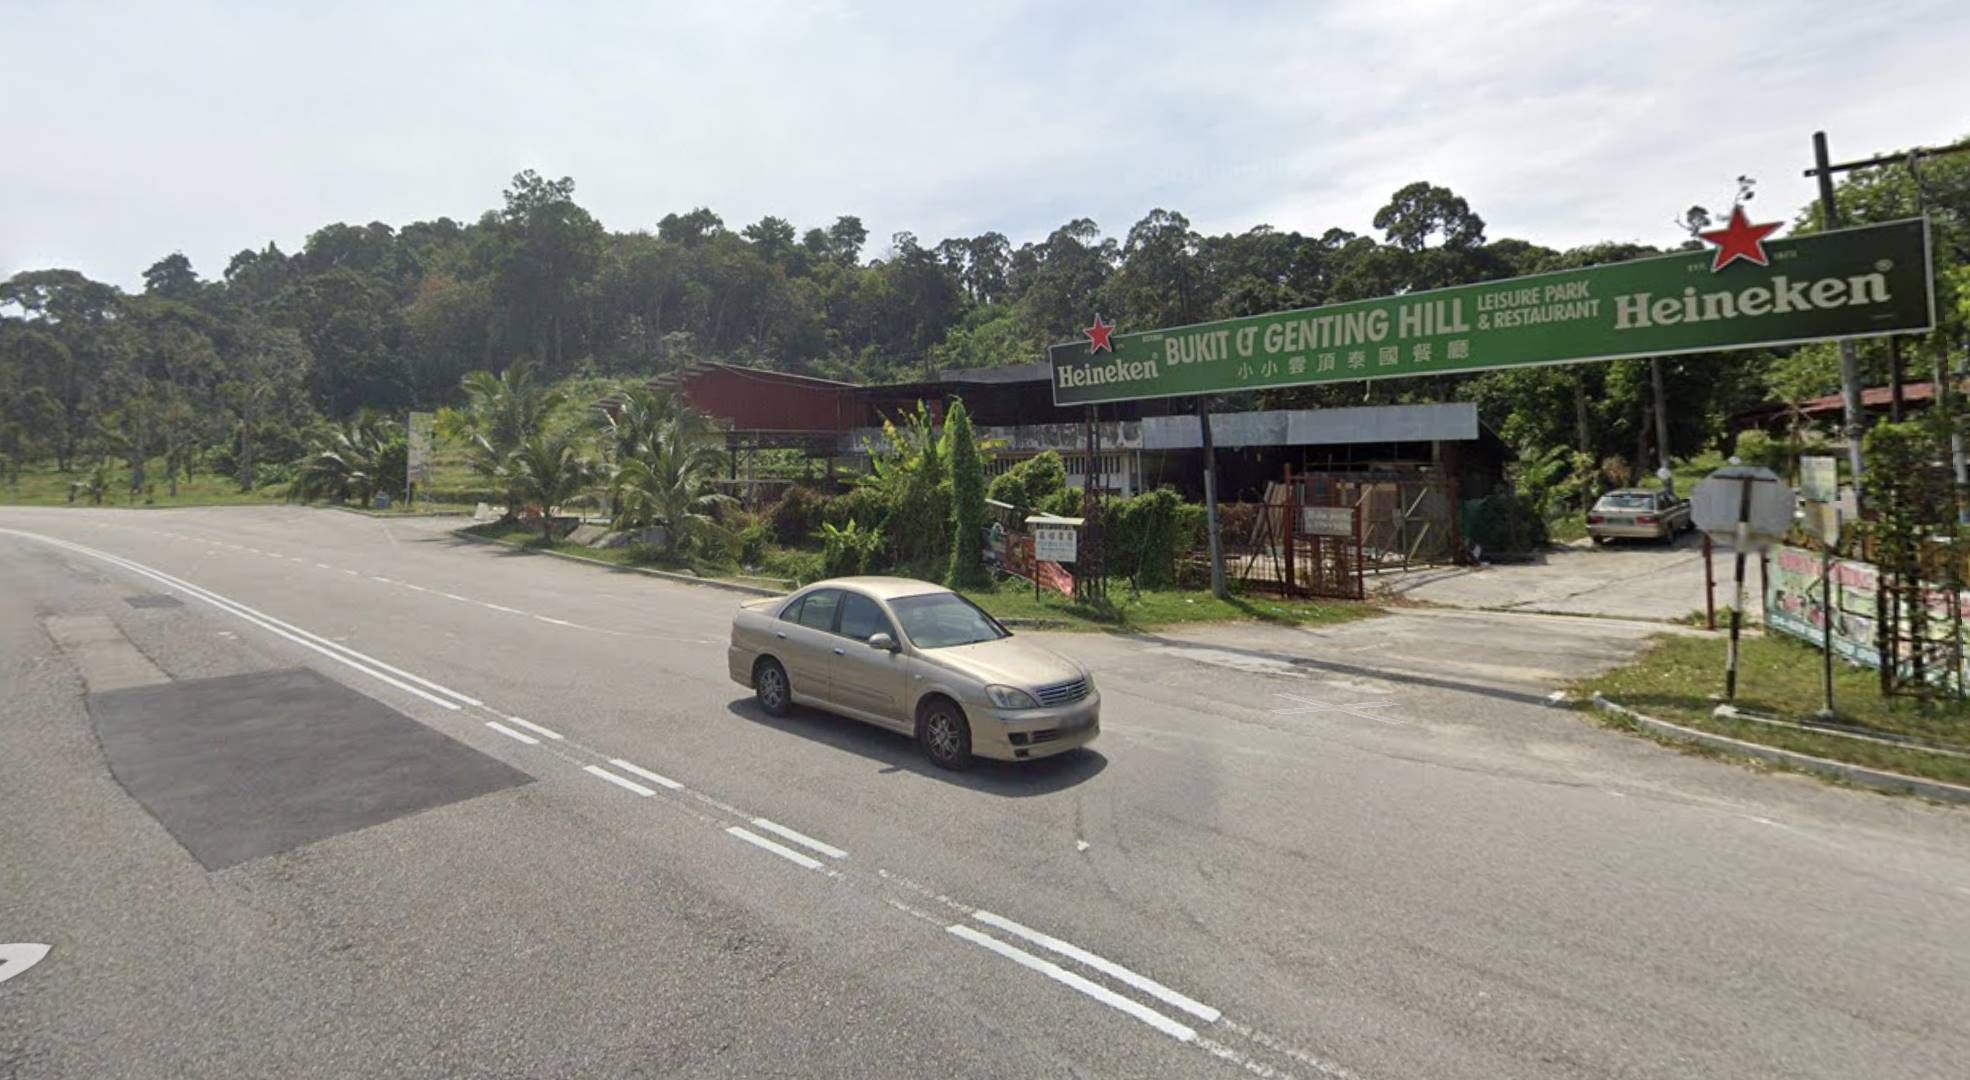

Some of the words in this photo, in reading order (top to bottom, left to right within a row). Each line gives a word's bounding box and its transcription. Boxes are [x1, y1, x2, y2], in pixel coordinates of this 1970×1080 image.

[1478, 287, 1541, 311] LEISURE
[1545, 280, 1590, 302] PARK
[1614, 272, 1892, 330] Heineken
[1478, 313, 1490, 329] &
[1494, 299, 1600, 328] RESTAURANT
[1165, 330, 1230, 366] BUKIT
[1264, 308, 1390, 353] GENTING
[1399, 298, 1470, 338] HILL
[1057, 359, 1159, 388] Heineken
